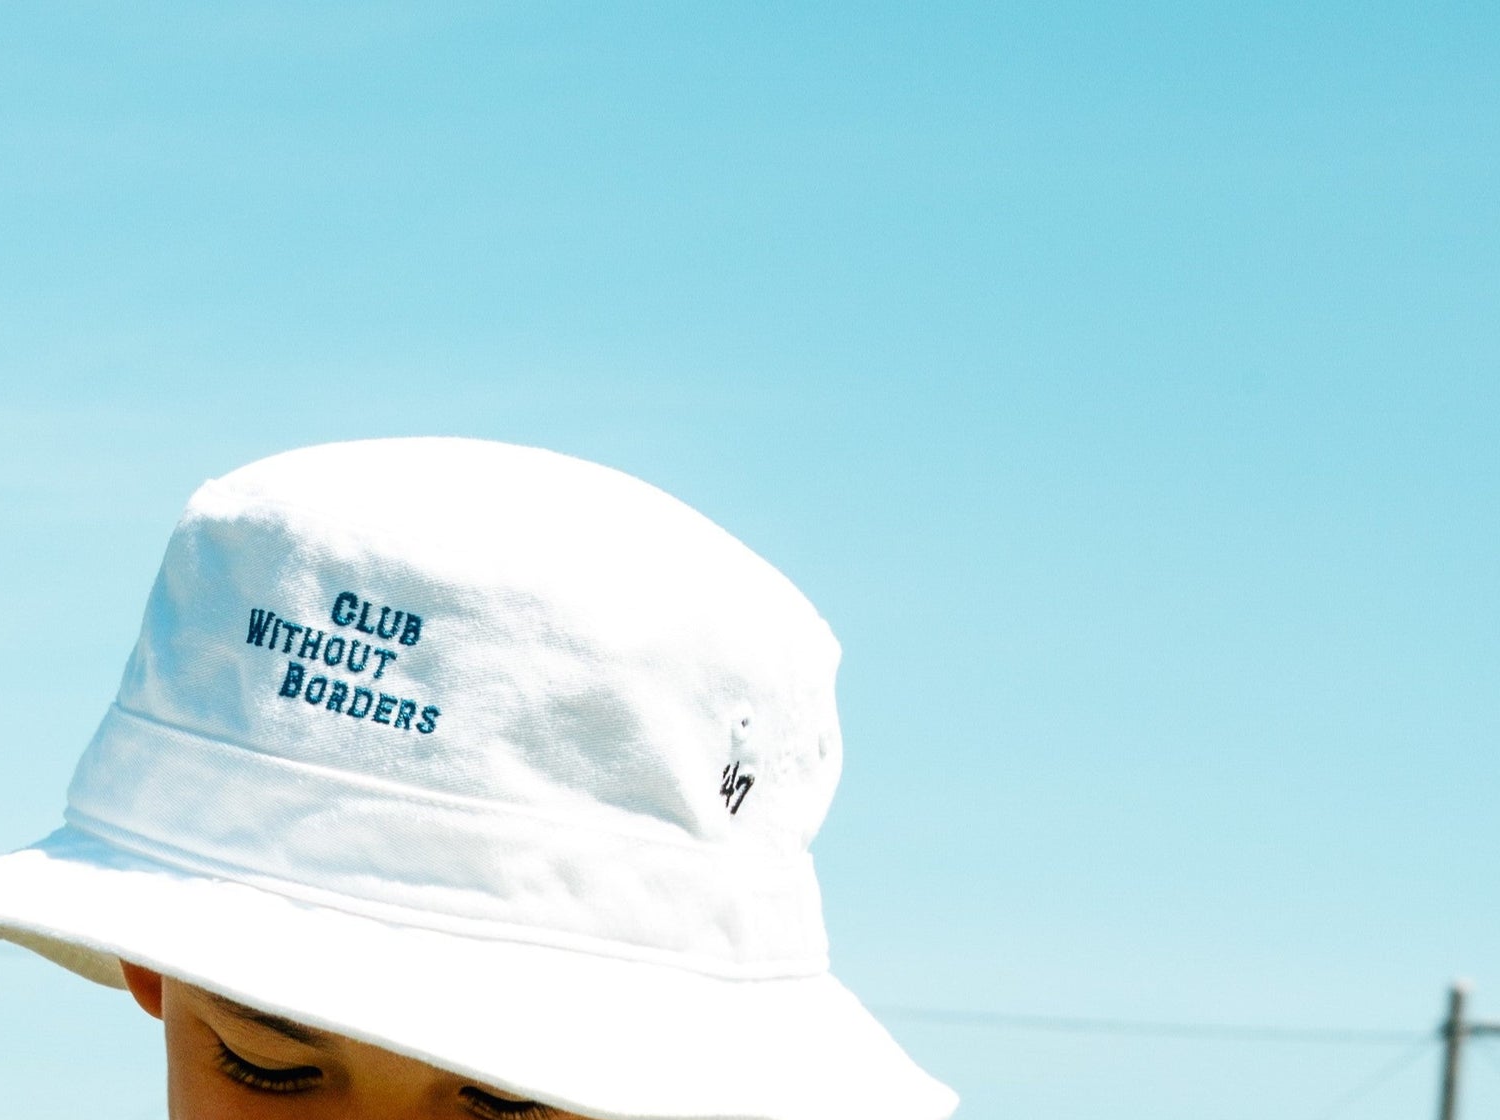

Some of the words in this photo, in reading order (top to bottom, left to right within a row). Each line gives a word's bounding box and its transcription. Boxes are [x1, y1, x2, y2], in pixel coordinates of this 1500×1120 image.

[246, 608, 398, 680] WITHOUT
[331, 591, 423, 647] CLUB
[278, 660, 441, 734] BORDERS
